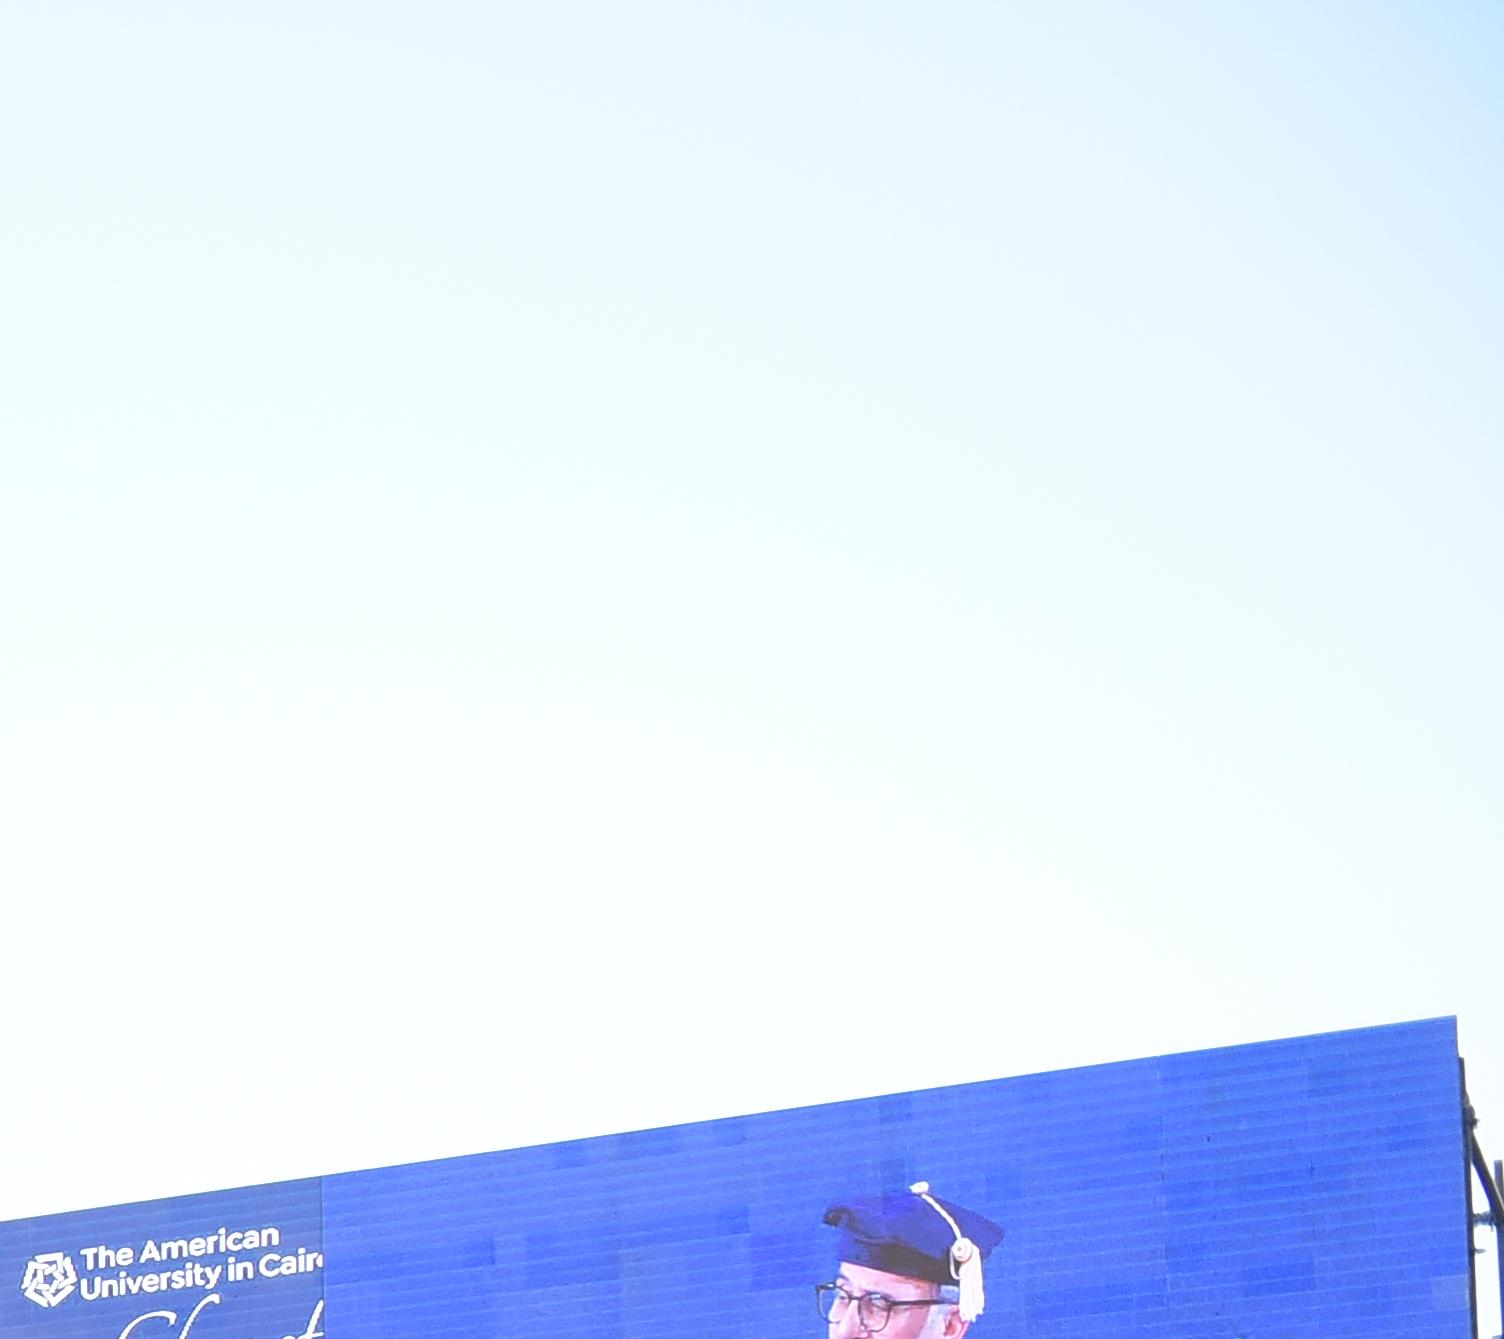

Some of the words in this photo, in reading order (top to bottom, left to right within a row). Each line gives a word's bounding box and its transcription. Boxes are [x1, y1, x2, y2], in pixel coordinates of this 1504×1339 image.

[79, 1245, 134, 1271] The
[139, 1227, 280, 1264] American
[80, 1261, 222, 1301] University
[227, 1256, 254, 1282] in
